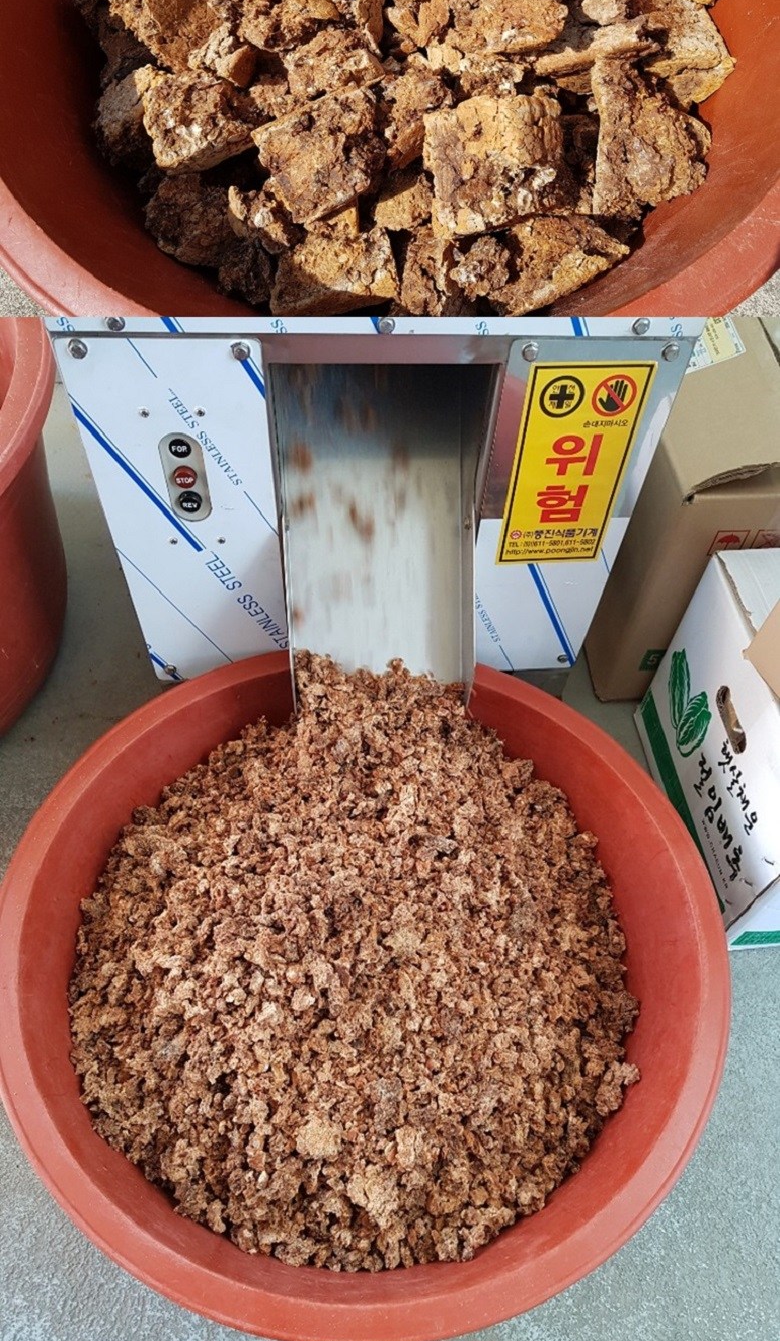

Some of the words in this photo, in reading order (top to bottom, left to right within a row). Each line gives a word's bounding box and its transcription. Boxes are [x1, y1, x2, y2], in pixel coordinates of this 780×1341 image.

[168, 393, 200, 429] STEEL
[582, 419, 629, 429] 손대지마시오
[171, 444, 189, 453] FOR
[197, 431, 243, 487] STAINLESS
[175, 476, 194, 484] STOP
[205, 552, 243, 591] STEEL
[237, 593, 290, 649] STAINLESS
